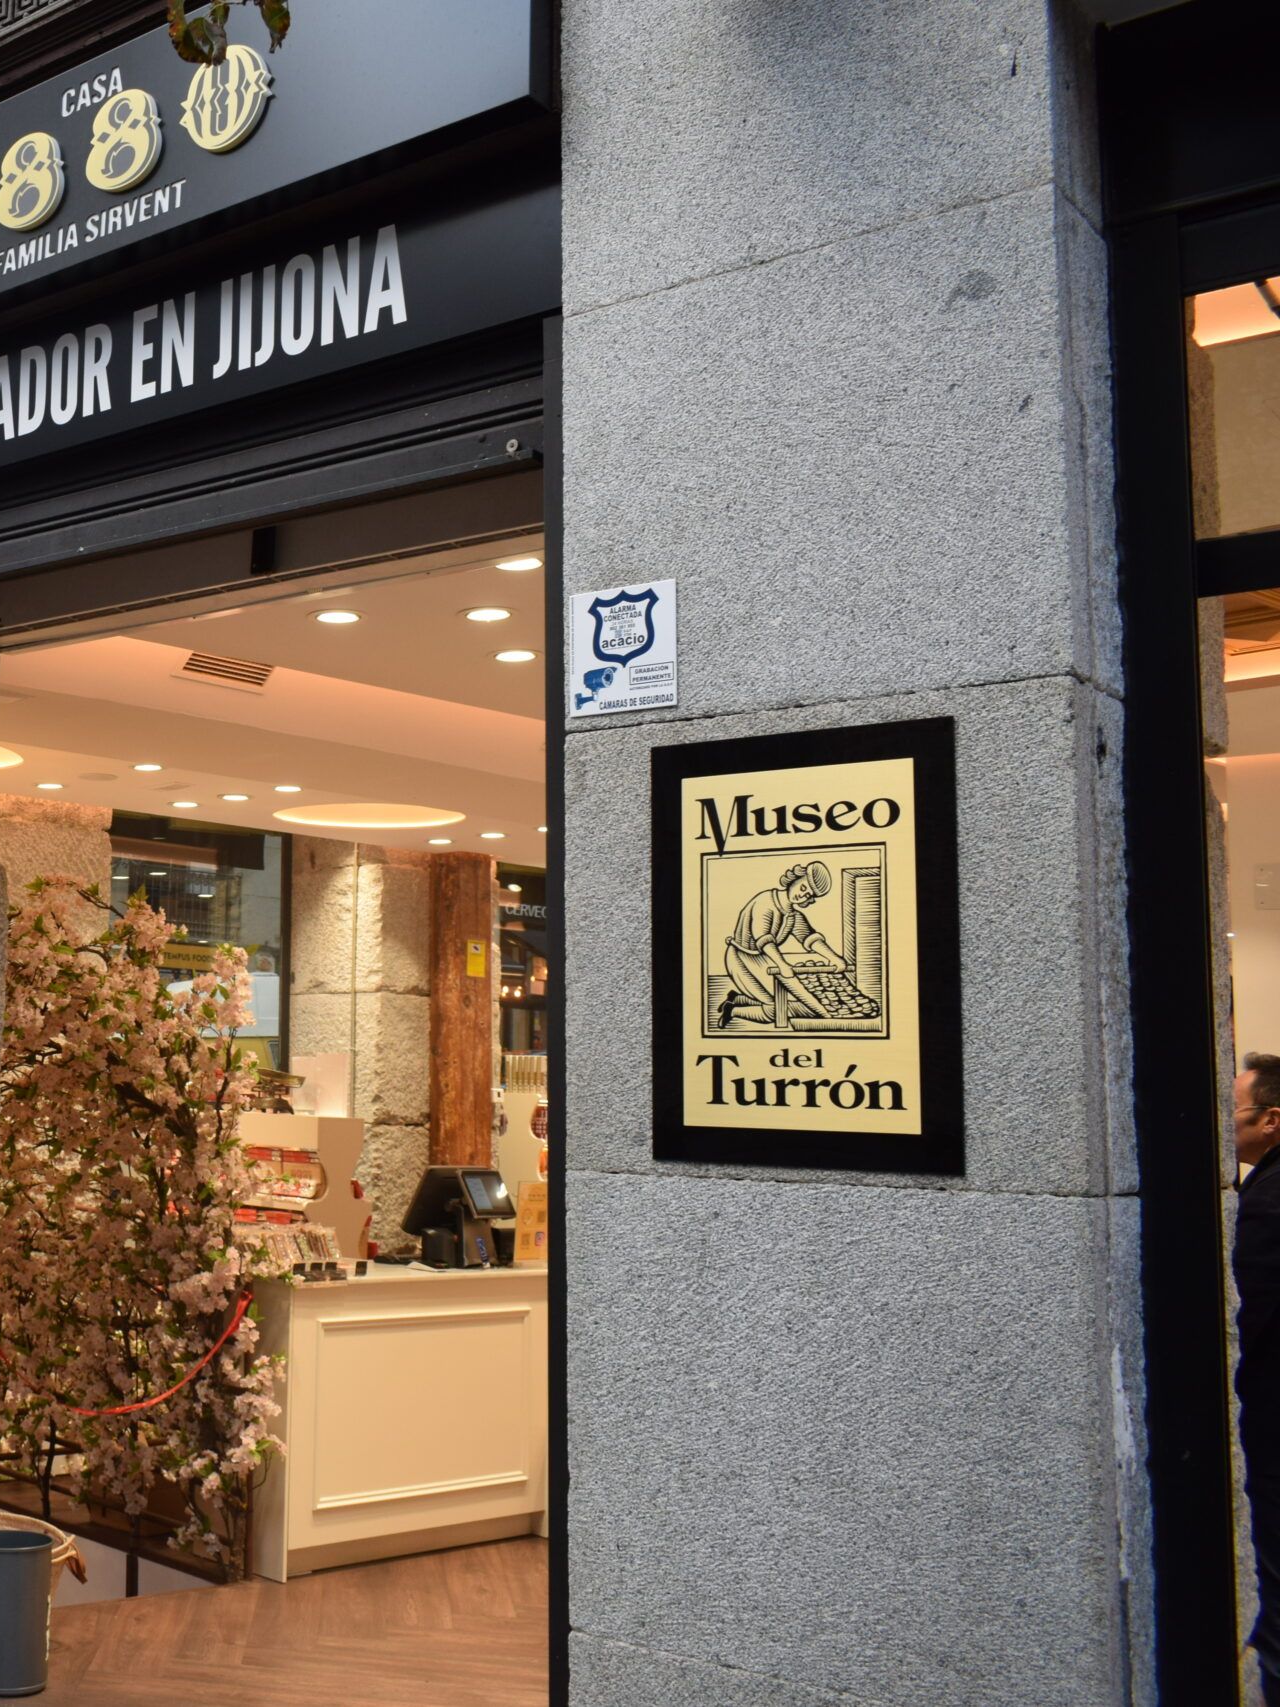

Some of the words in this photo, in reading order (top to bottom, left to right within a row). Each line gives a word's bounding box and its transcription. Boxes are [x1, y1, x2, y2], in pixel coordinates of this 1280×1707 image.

[60, 66, 123, 118] CASA
[84, 178, 187, 243] SIRVENT
[130, 291, 196, 404] EN
[212, 223, 407, 380] JIJONA
[603, 611, 642, 622] CONECTADA
[609, 604, 637, 614] ALARMA
[601, 633, 645, 649] acacio
[629, 697, 637, 707] DE
[639, 693, 674, 705] SEGURIDAD
[695, 794, 900, 857] Museo
[769, 1048, 824, 1068] del
[695, 1054, 908, 1111] Turrón
